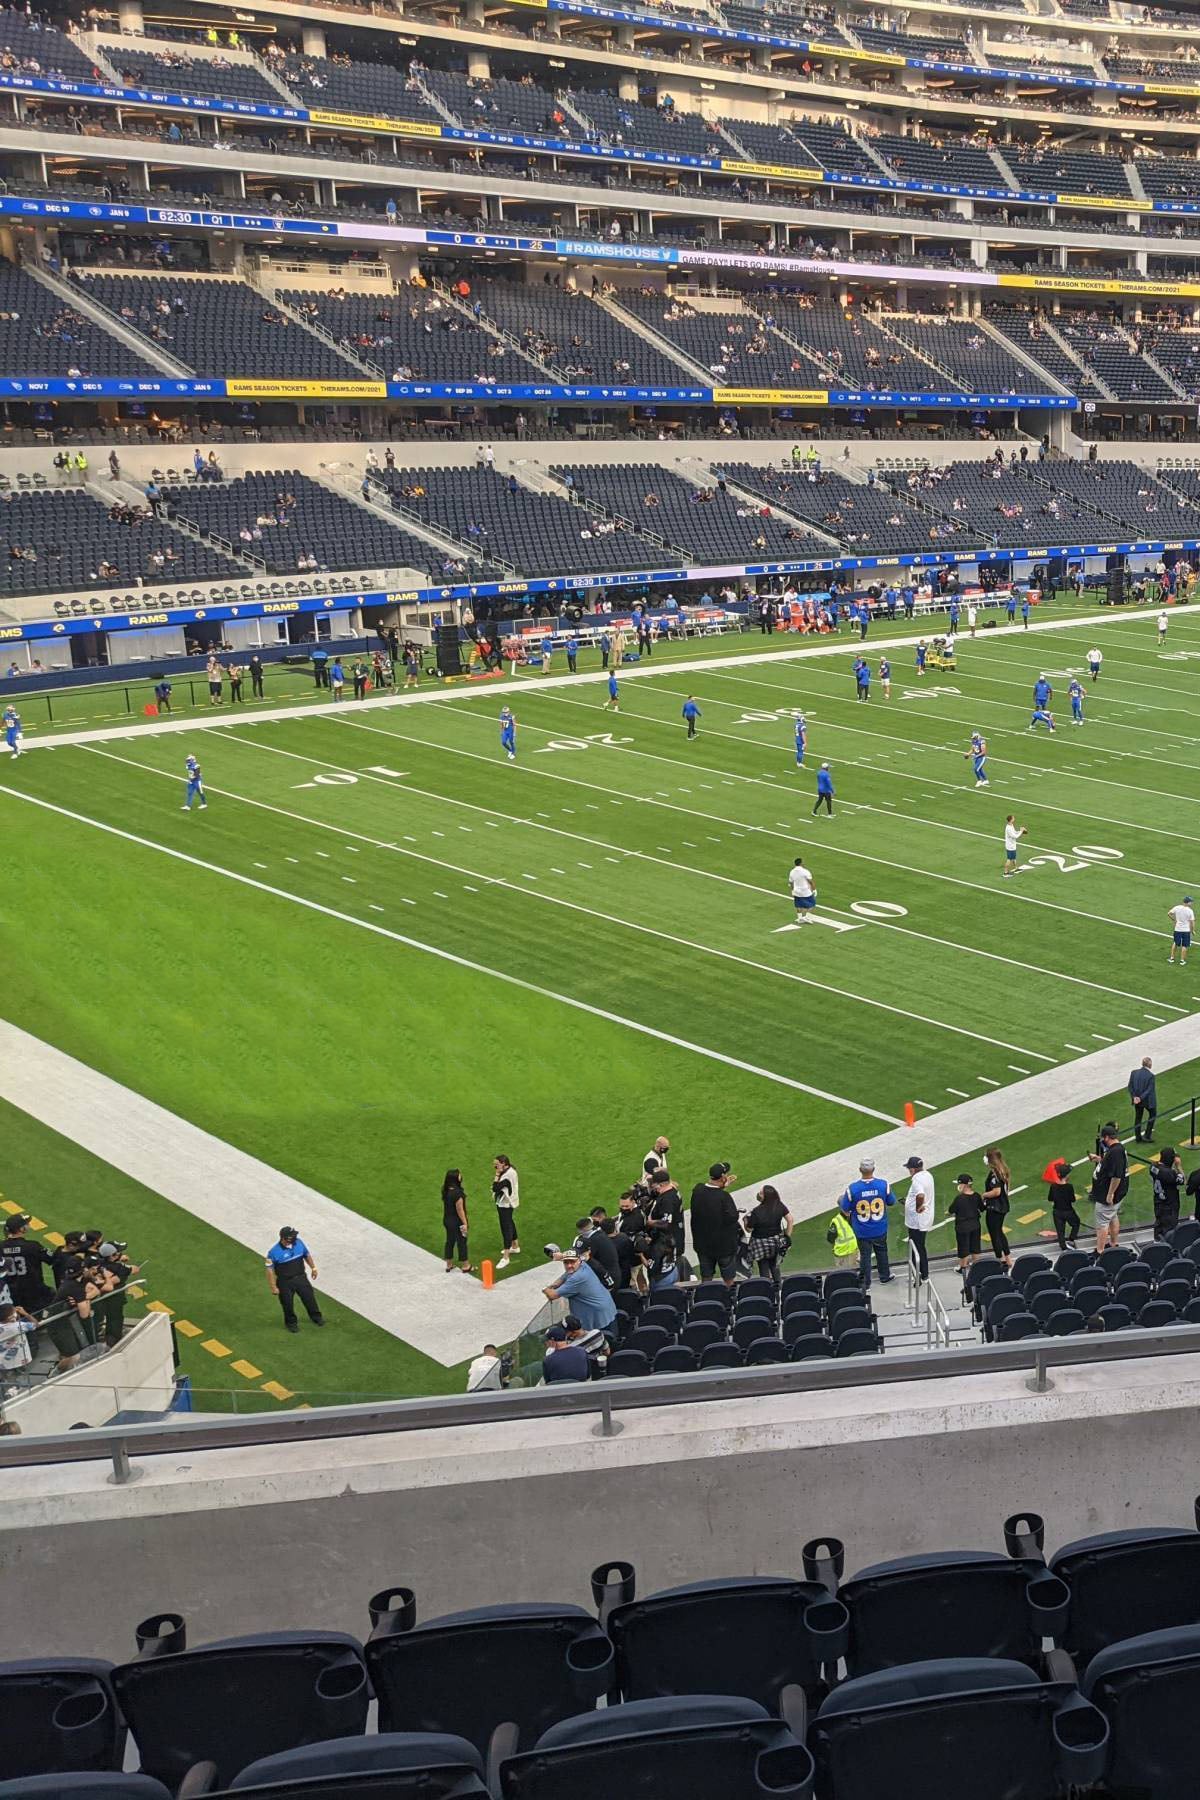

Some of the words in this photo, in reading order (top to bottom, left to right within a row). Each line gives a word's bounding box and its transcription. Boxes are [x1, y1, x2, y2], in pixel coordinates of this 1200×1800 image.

[46, 204, 61, 212] DEC
[160, 212, 192, 223] 62:30
[212, 215, 222, 224] Q1
[454, 234, 461, 244] 0
[566, 244, 660, 258] #RAMSHOUSE
[682, 255, 707, 266] GAME
[730, 259, 748, 269] LETS
[750, 260, 761, 270] GO
[764, 260, 787, 272] RAMS!
[1119, 284, 1179, 292] THERAMS.COM/2021
[574, 578, 593, 587] 62:30
[129, 614, 168, 625] RAMS
[264, 602, 299, 612] RAMS
[387, 592, 418, 602] RAMS
[498, 583, 528, 592] RAMS
[856, 1198, 885, 1222] 99
